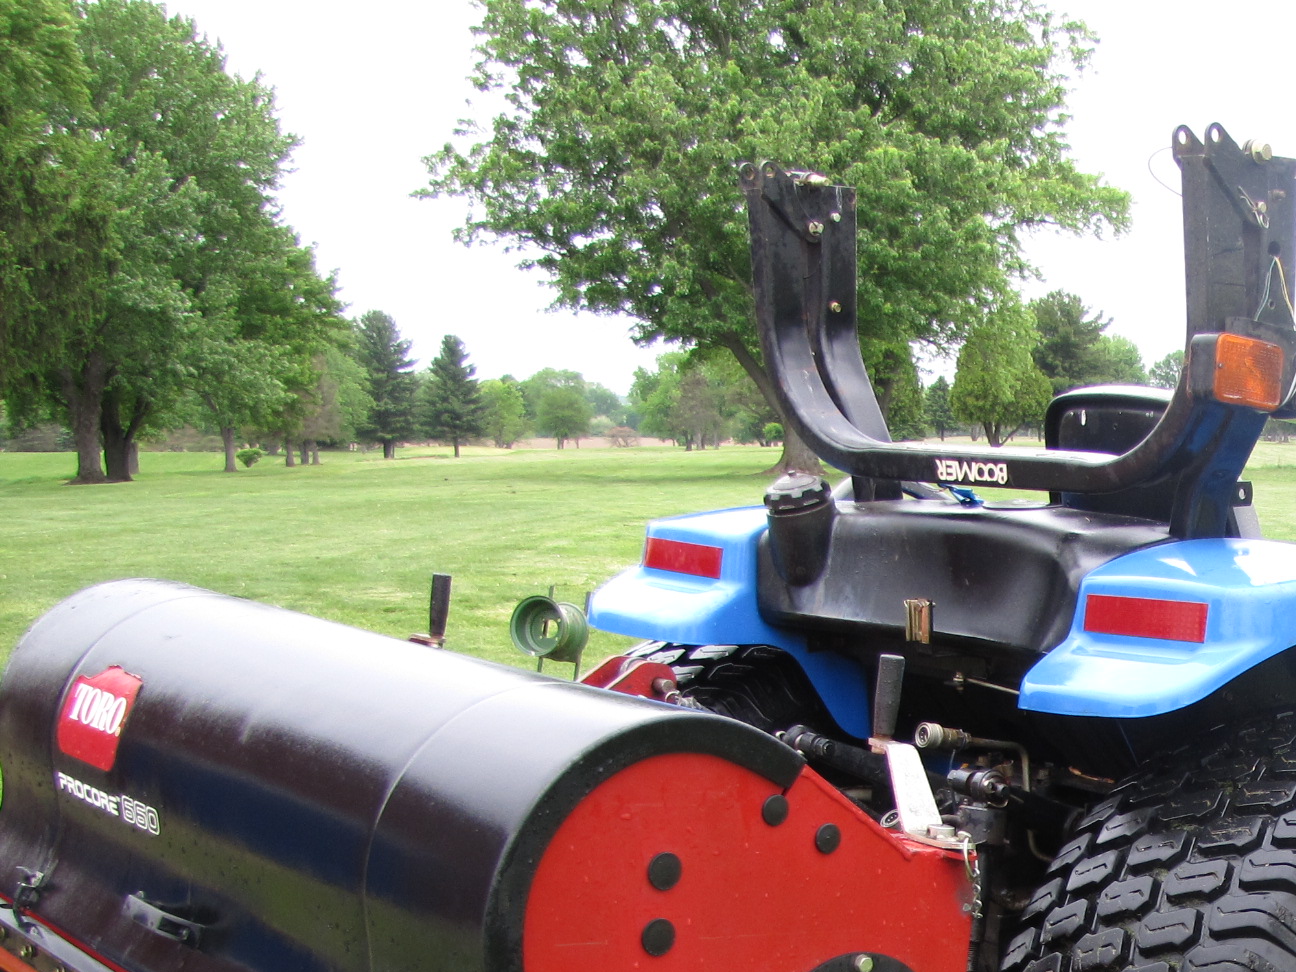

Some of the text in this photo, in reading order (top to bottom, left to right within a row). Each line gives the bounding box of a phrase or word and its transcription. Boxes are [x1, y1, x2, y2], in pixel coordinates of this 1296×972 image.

[935, 459, 1008, 485] BOOMER
[69, 683, 127, 735] TORO
[57, 771, 120, 816] PROCORE
